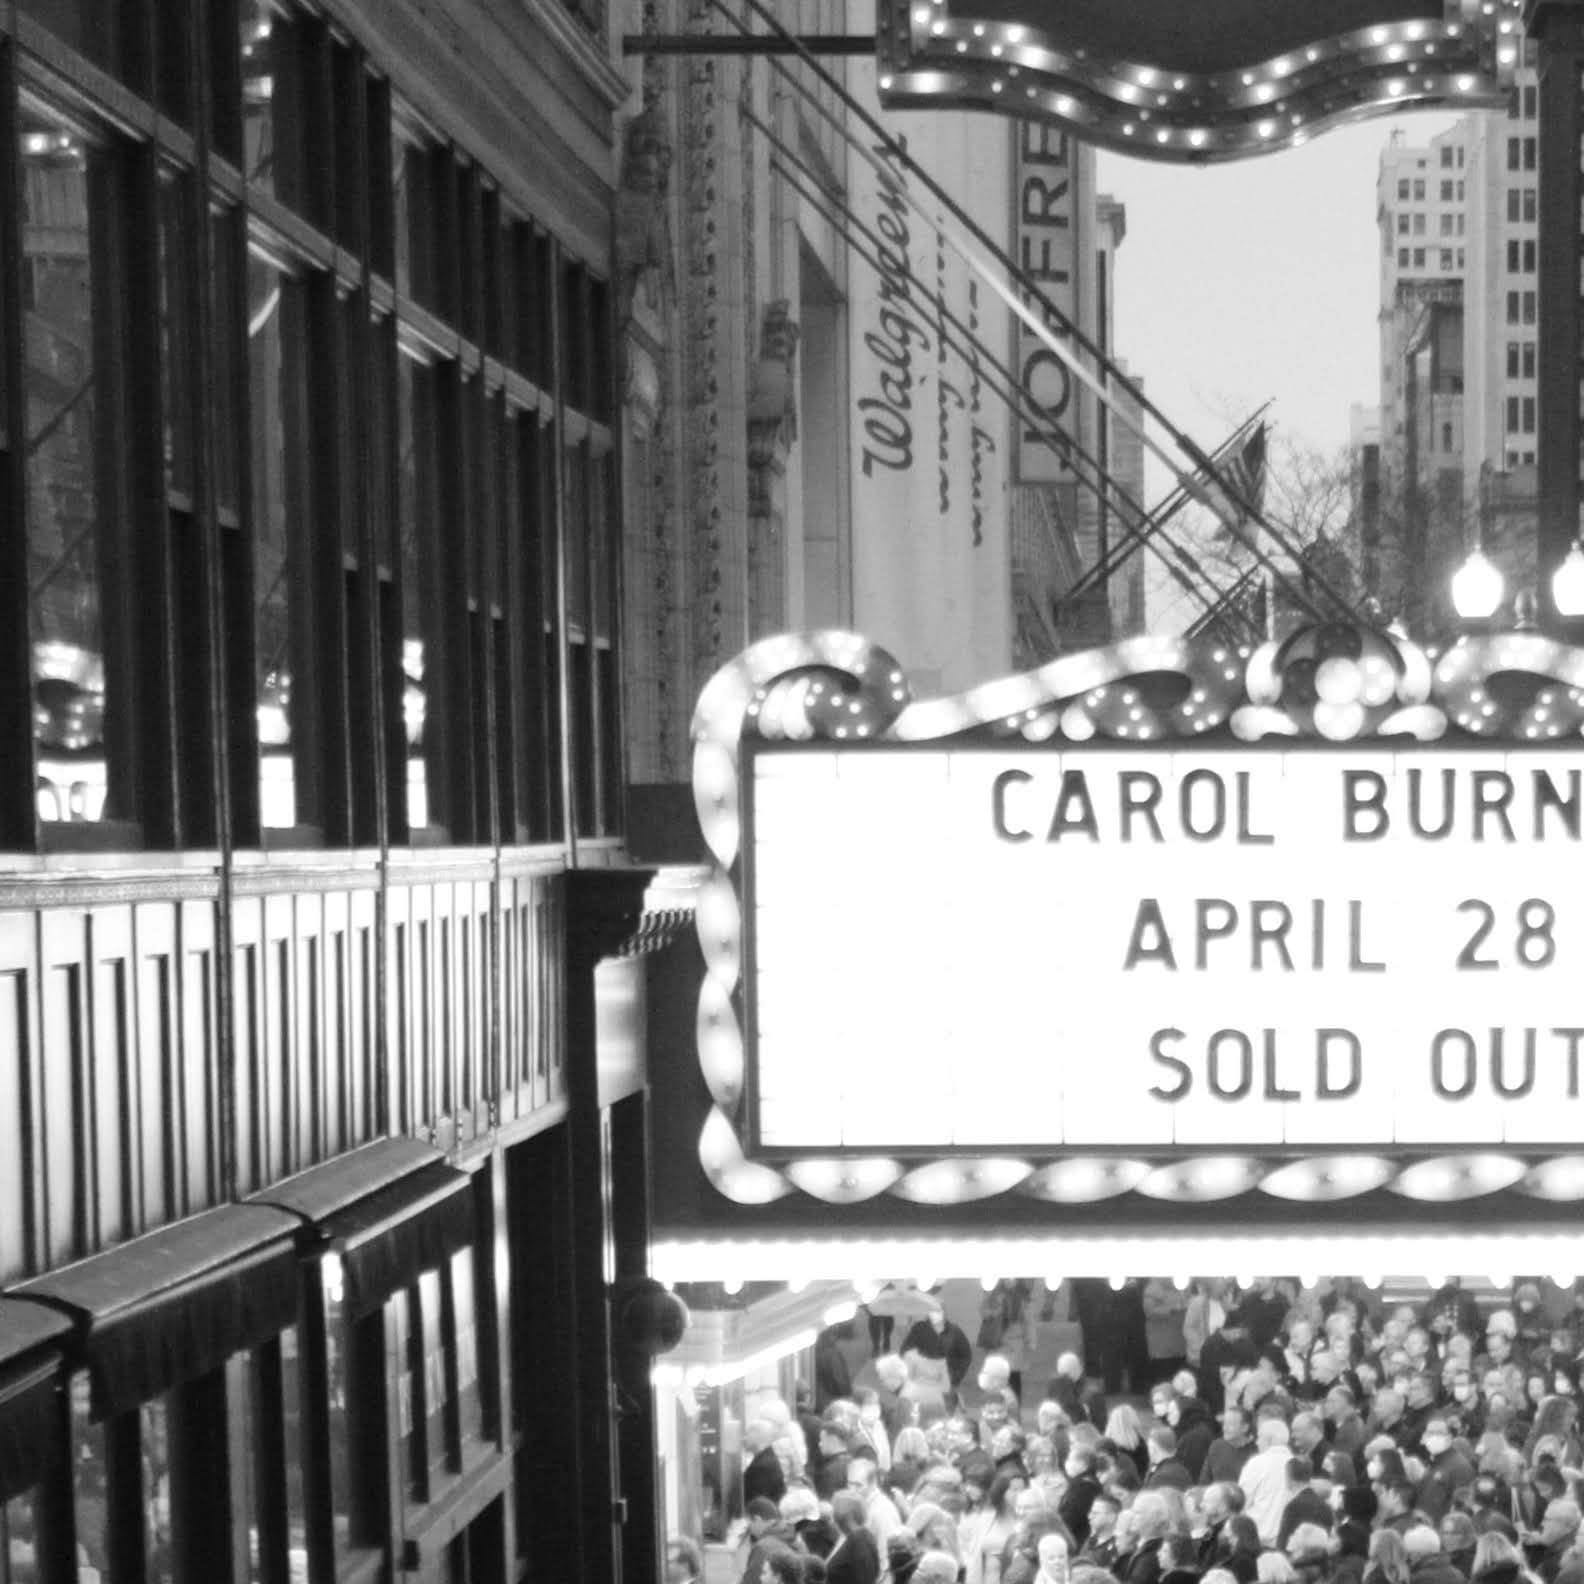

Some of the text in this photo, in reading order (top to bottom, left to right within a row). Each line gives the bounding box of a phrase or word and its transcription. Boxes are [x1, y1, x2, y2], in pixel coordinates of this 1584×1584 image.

[858, 133, 931, 478] Walgreens
[993, 768, 1275, 845] CAROL
[1122, 897, 1558, 973] APRIL 28
[1147, 1027, 1363, 1104] SOLD
